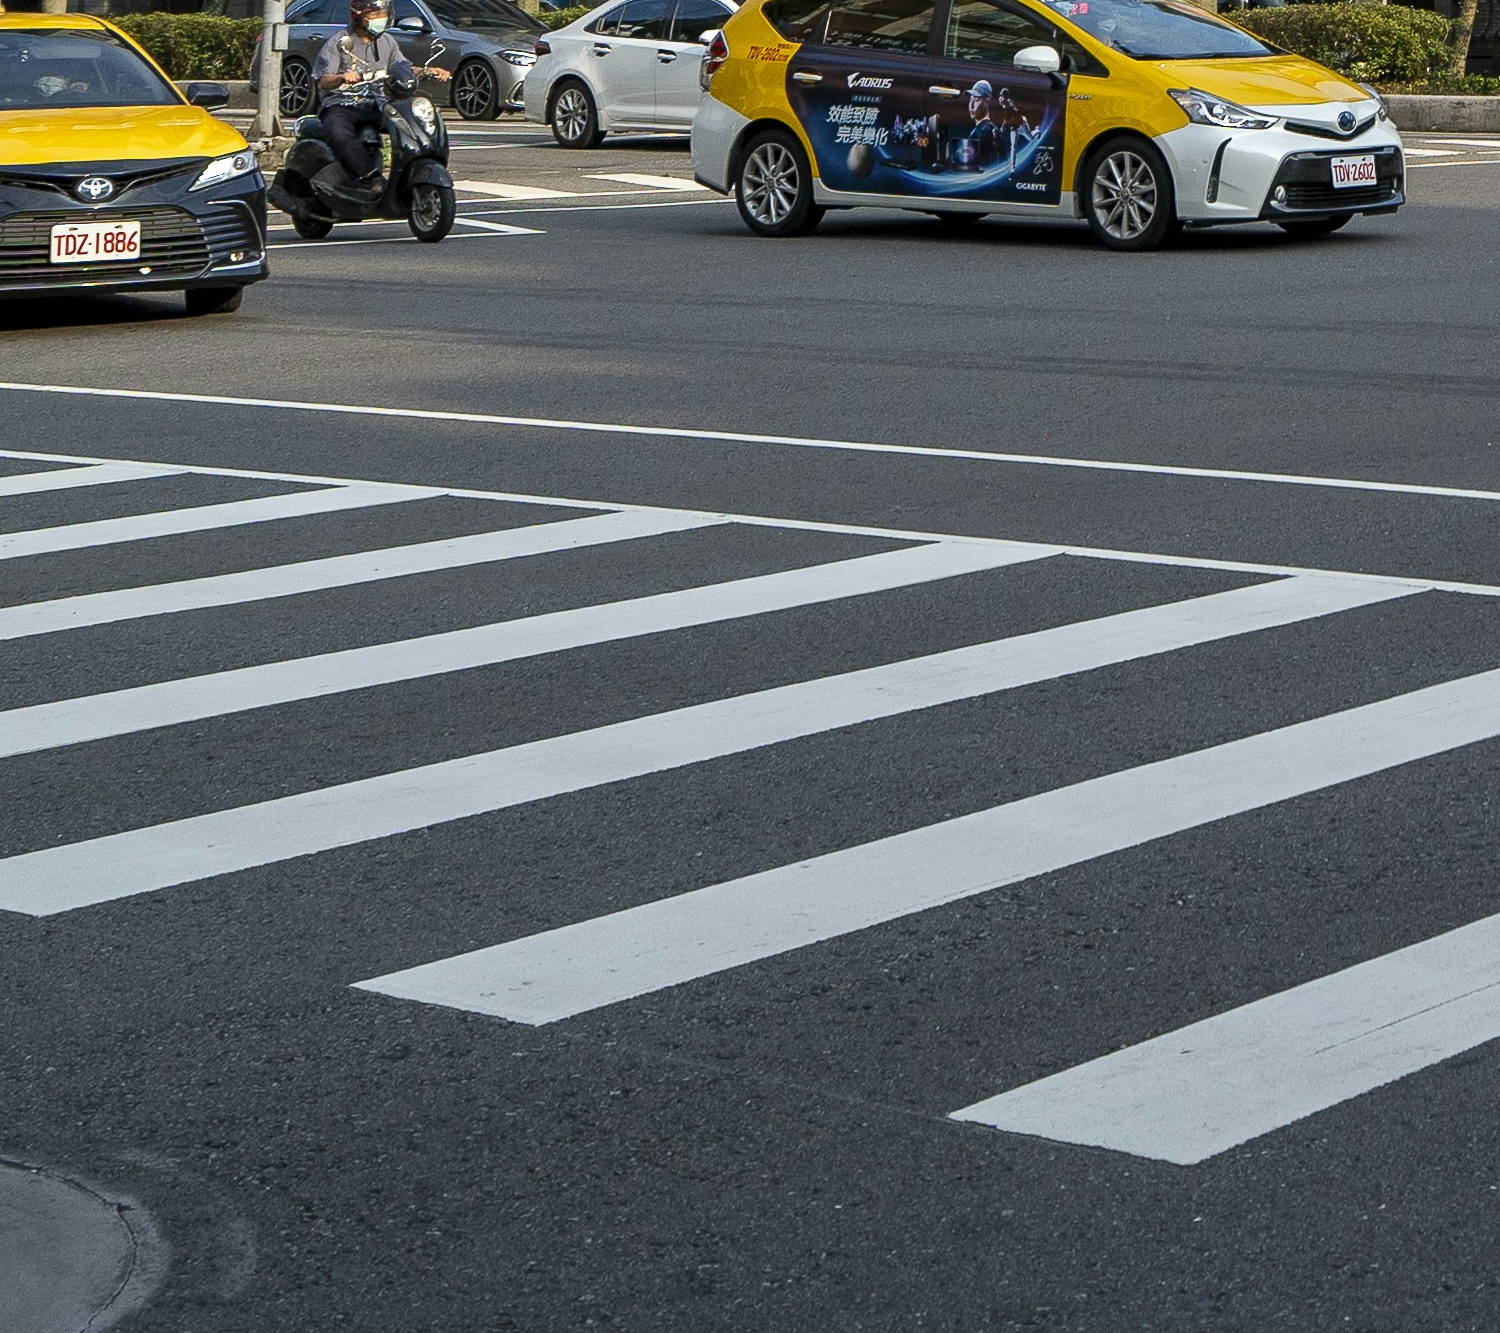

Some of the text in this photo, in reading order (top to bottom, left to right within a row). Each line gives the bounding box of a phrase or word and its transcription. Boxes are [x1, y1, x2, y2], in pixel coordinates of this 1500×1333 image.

[825, 104, 881, 126] 效能致勝
[834, 125, 889, 148] 完美變化
[53, 230, 138, 257] TDZ-1886
